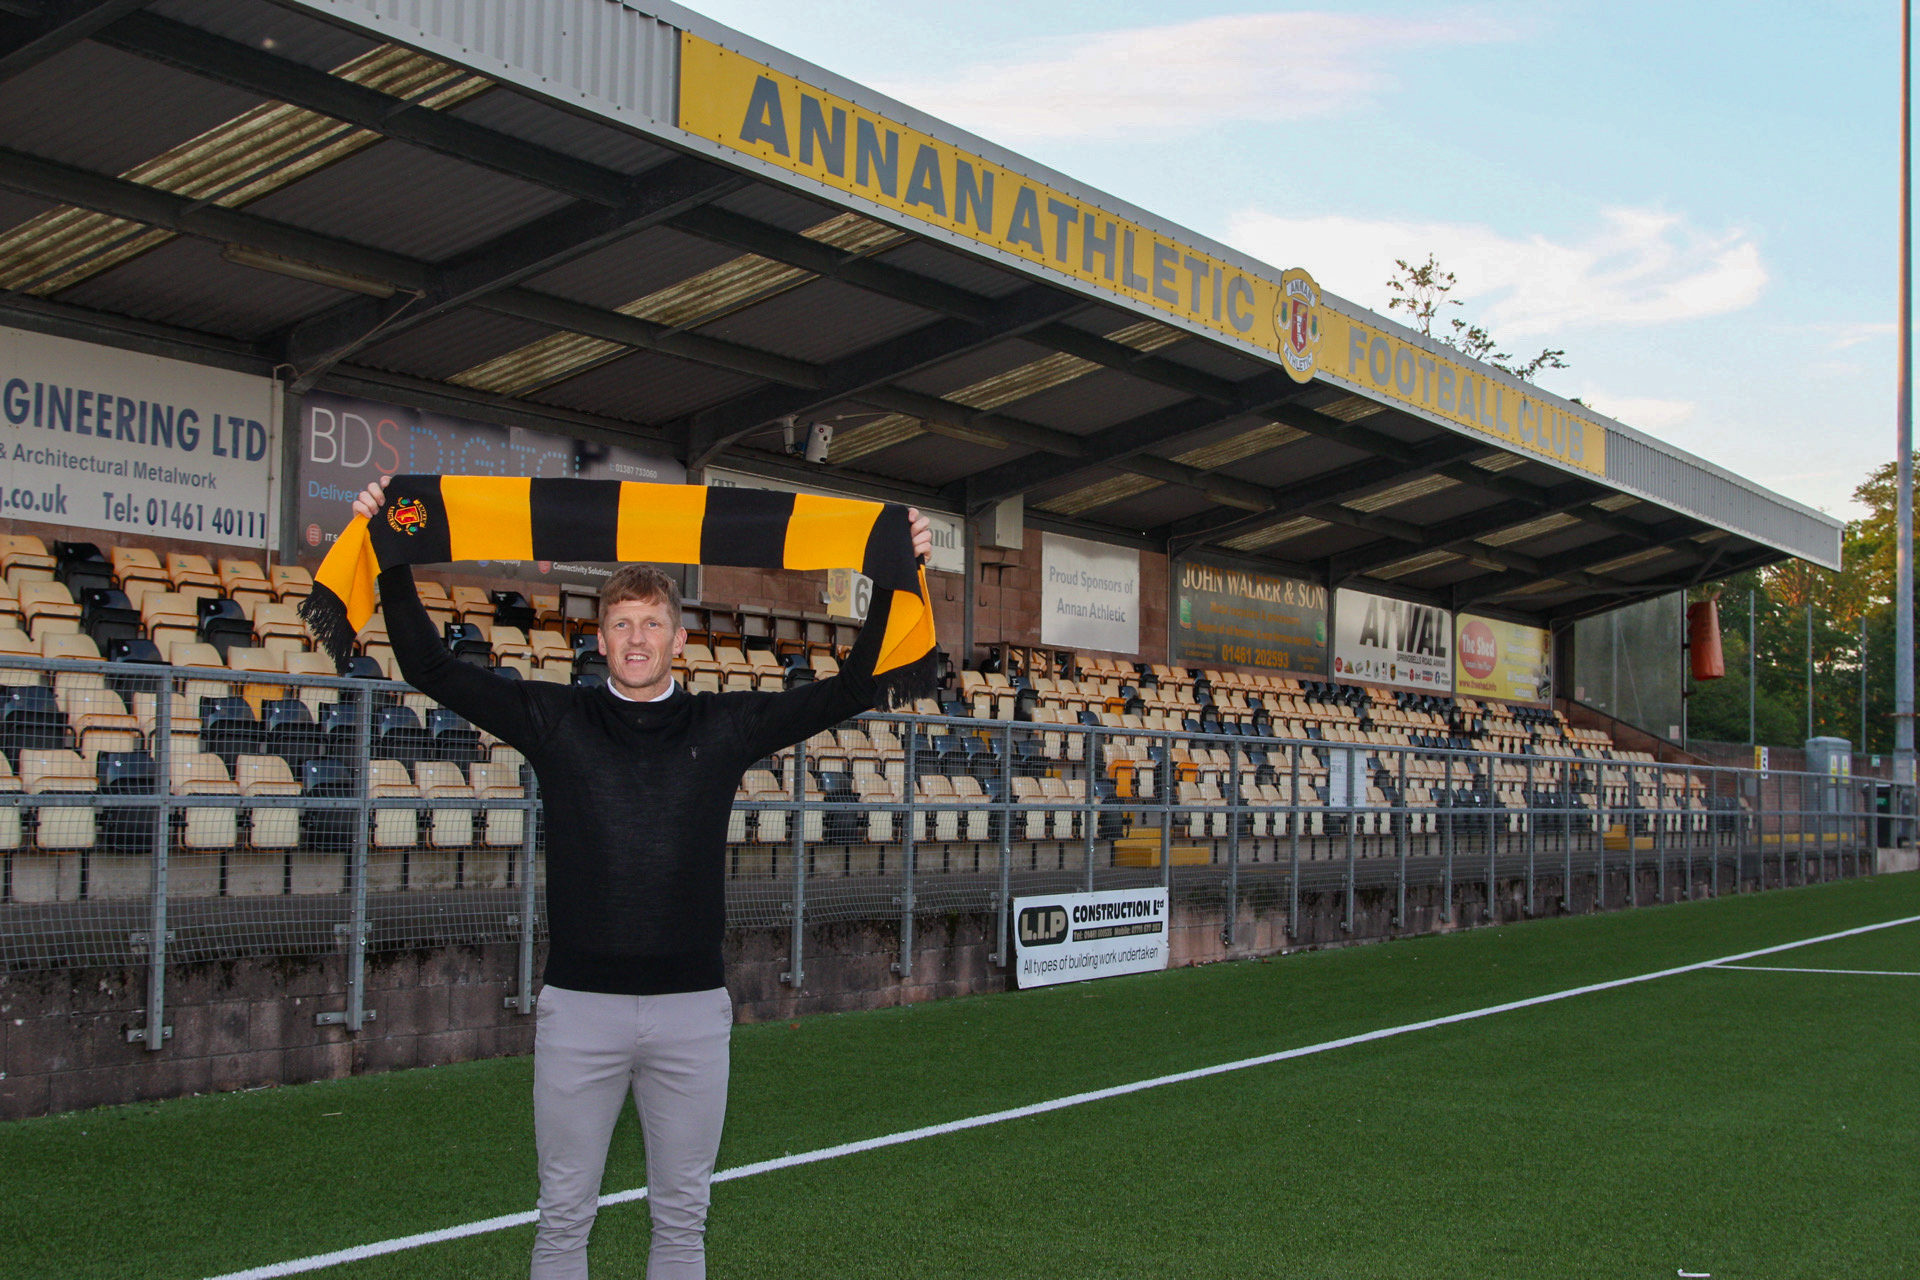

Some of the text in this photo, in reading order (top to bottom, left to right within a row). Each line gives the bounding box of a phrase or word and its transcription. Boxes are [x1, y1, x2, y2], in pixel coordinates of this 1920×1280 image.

[739, 74, 1256, 333] ANNAN ATHLETIC
[1290, 280, 1313, 304] ANNAN
[1284, 347, 1313, 371] ATHLETIC
[1349, 326, 1584, 462] FOOTBALL CLUB
[3, 378, 267, 462] GINEERING LTD
[311, 406, 399, 475] BDS
[12, 443, 128, 477] Architectural
[133, 461, 217, 489] Metalwork
[308, 480, 363, 503] Deliver
[103, 491, 140, 524] Tel:
[146, 498, 203, 531] 01461
[211, 507, 266, 540] 40111
[553, 562, 588, 576] Connectivity
[1049, 565, 1134, 595] Proud Sponsors of
[855, 578, 869, 618] 6
[1182, 562, 1325, 611] JOHN WALKER & SON
[1056, 598, 1126, 623] Annan Athletic
[1359, 596, 1447, 659] ATWAL
[1222, 643, 1252, 665] 01461
[1254, 648, 1290, 669] 202593
[1462, 632, 1476, 654] The
[1476, 636, 1496, 658] Shed
[1072, 900, 1151, 924] CONSTRUCTION
[1153, 899, 1165, 916] Ltd
[1023, 945, 1159, 977] All types of building work undertaken
